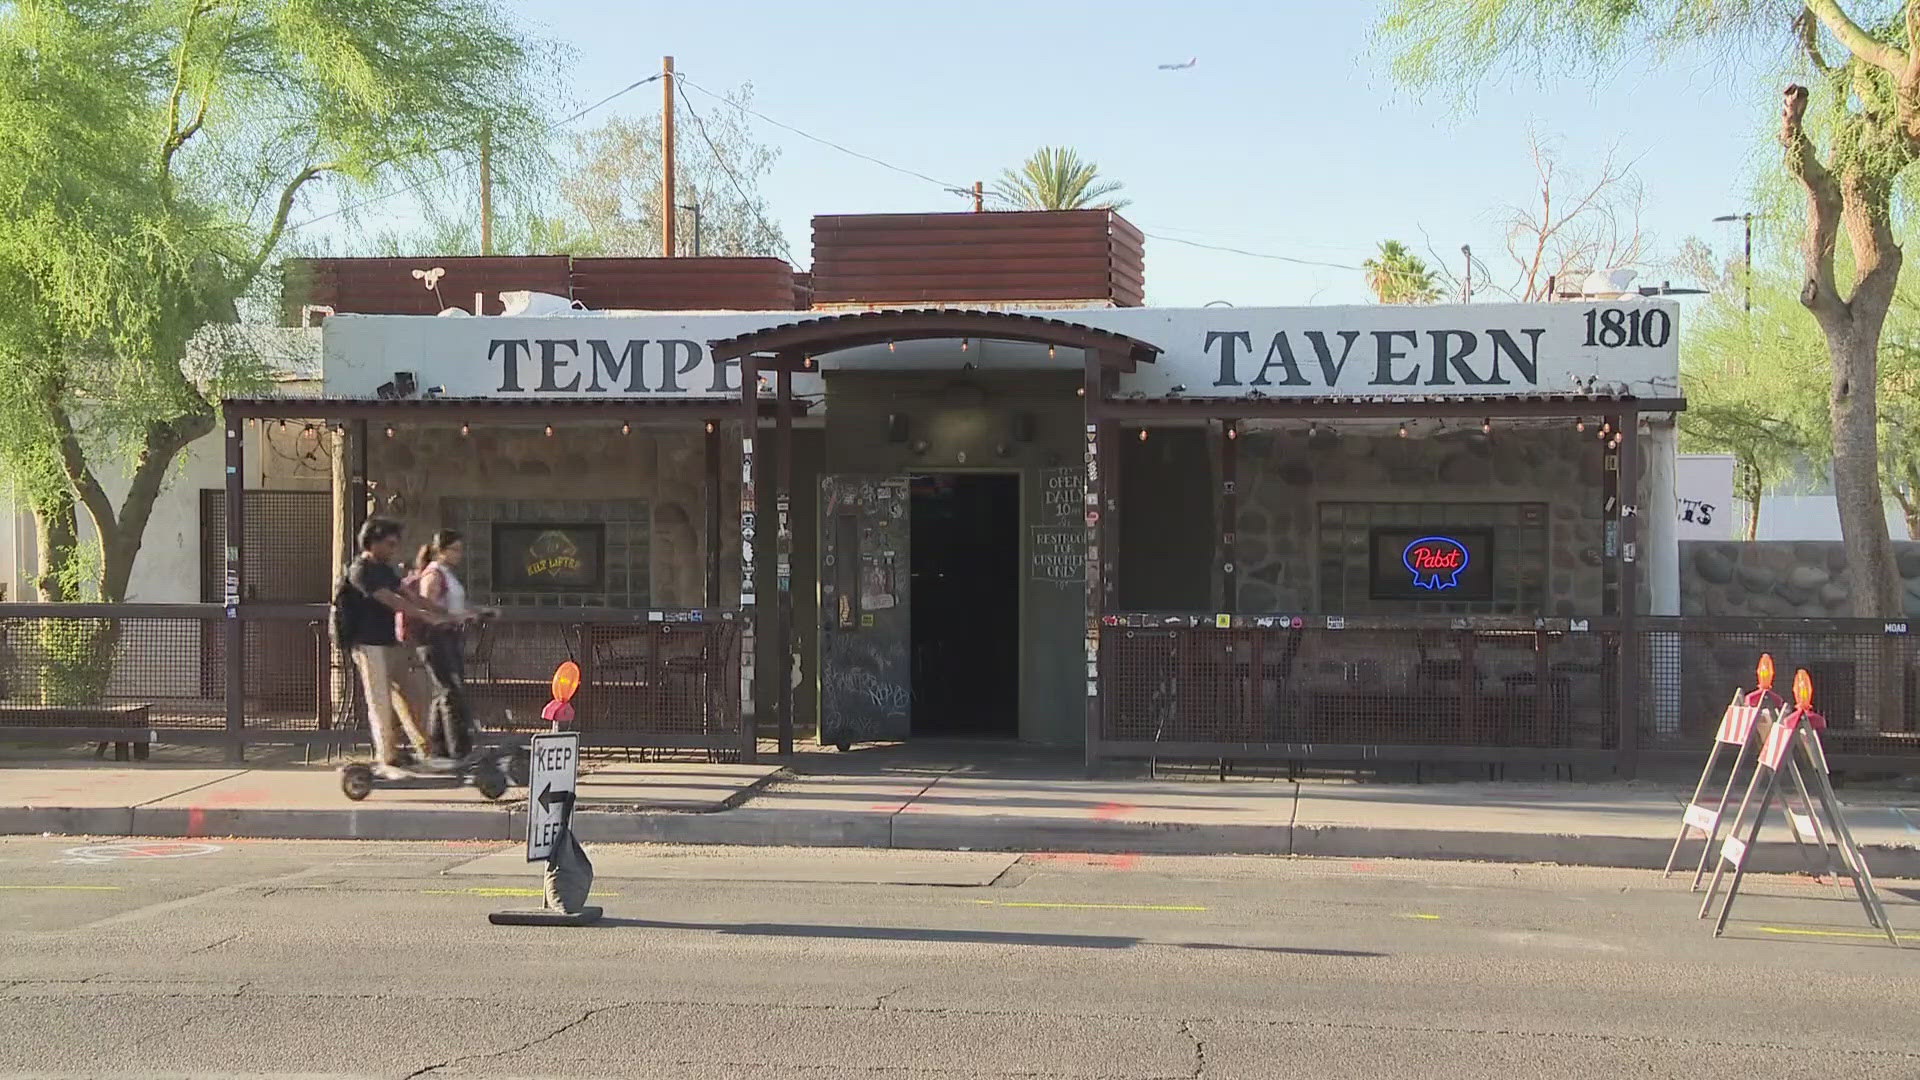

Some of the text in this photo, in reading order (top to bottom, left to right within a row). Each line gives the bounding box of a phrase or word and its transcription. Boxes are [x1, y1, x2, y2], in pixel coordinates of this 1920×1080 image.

[1581, 307, 1671, 348] 1810
[1203, 329, 1546, 387] TAVERN
[1049, 475, 1083, 488] OPEN
[1678, 498, 1716, 525] TS
[1037, 533, 1086, 545] RESTROO
[1414, 547, 1460, 568] Pabst
[537, 747, 572, 773] KEEP
[534, 822, 560, 848] LEF
